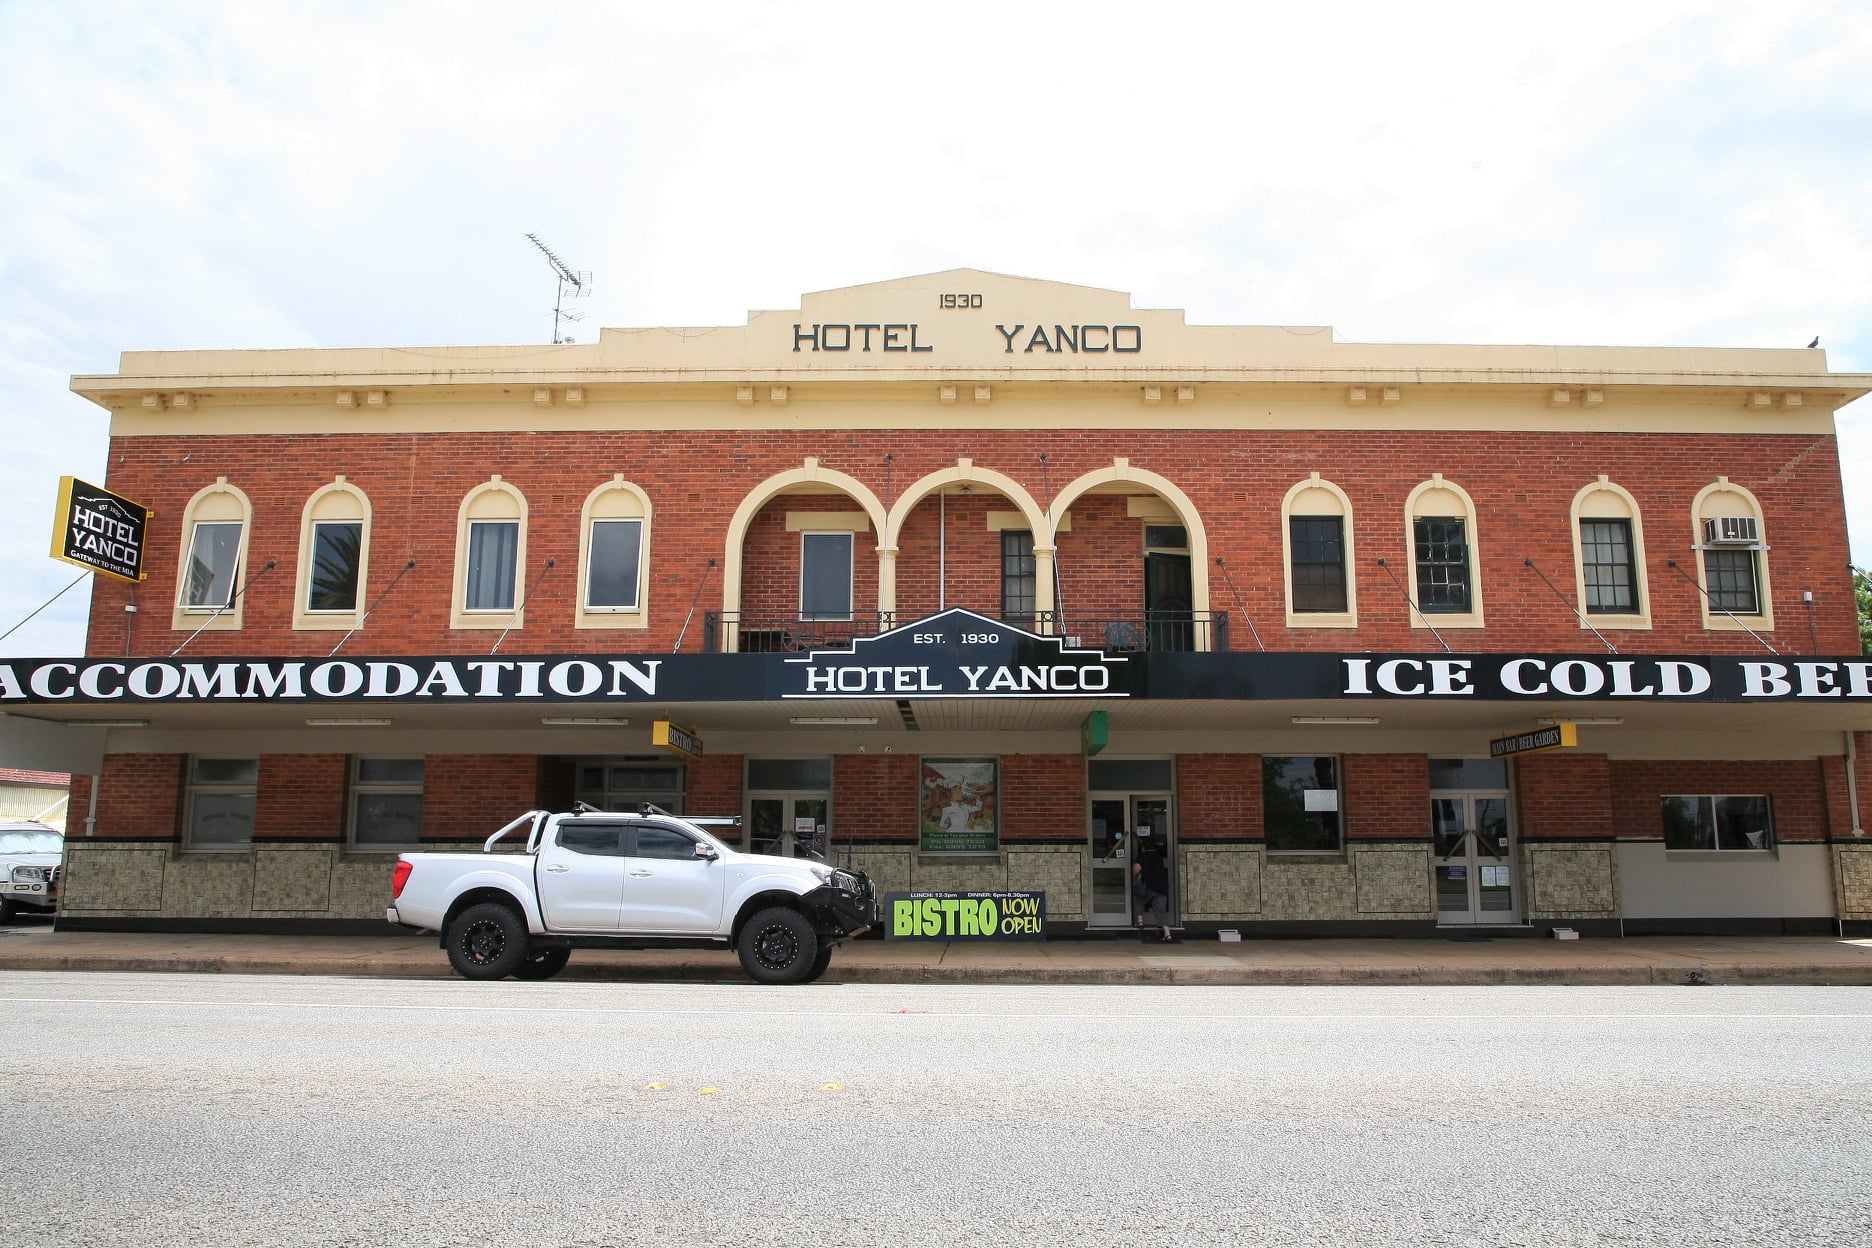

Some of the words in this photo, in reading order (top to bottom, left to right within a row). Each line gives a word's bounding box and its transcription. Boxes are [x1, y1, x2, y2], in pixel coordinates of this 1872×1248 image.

[939, 293, 983, 309] 1930
[792, 324, 933, 353] HOTEL
[995, 324, 1142, 353] YANCO
[73, 504, 139, 547] HOTEL
[72, 527, 138, 567] YANCO
[70, 549, 101, 565] GATEWAY
[101, 560, 110, 568] TO
[110, 563, 122, 573] THE
[122, 566, 134, 577] MIA
[913, 633, 946, 644] EST.
[961, 633, 1000, 644] 1930
[0, 660, 663, 699] ACCOMMODATION
[806, 666, 943, 692] HOTEL
[959, 665, 1109, 691] YANCO
[1342, 658, 1475, 696] ICE
[1499, 658, 1712, 698] COLD
[669, 727, 692, 752] BISTRO
[1519, 735, 1534, 750] BEER
[1534, 729, 1559, 747] GARDEN
[894, 898, 998, 936] BISTRO
[1002, 897, 1040, 916] NOW
[1001, 916, 1042, 935] OPEN
